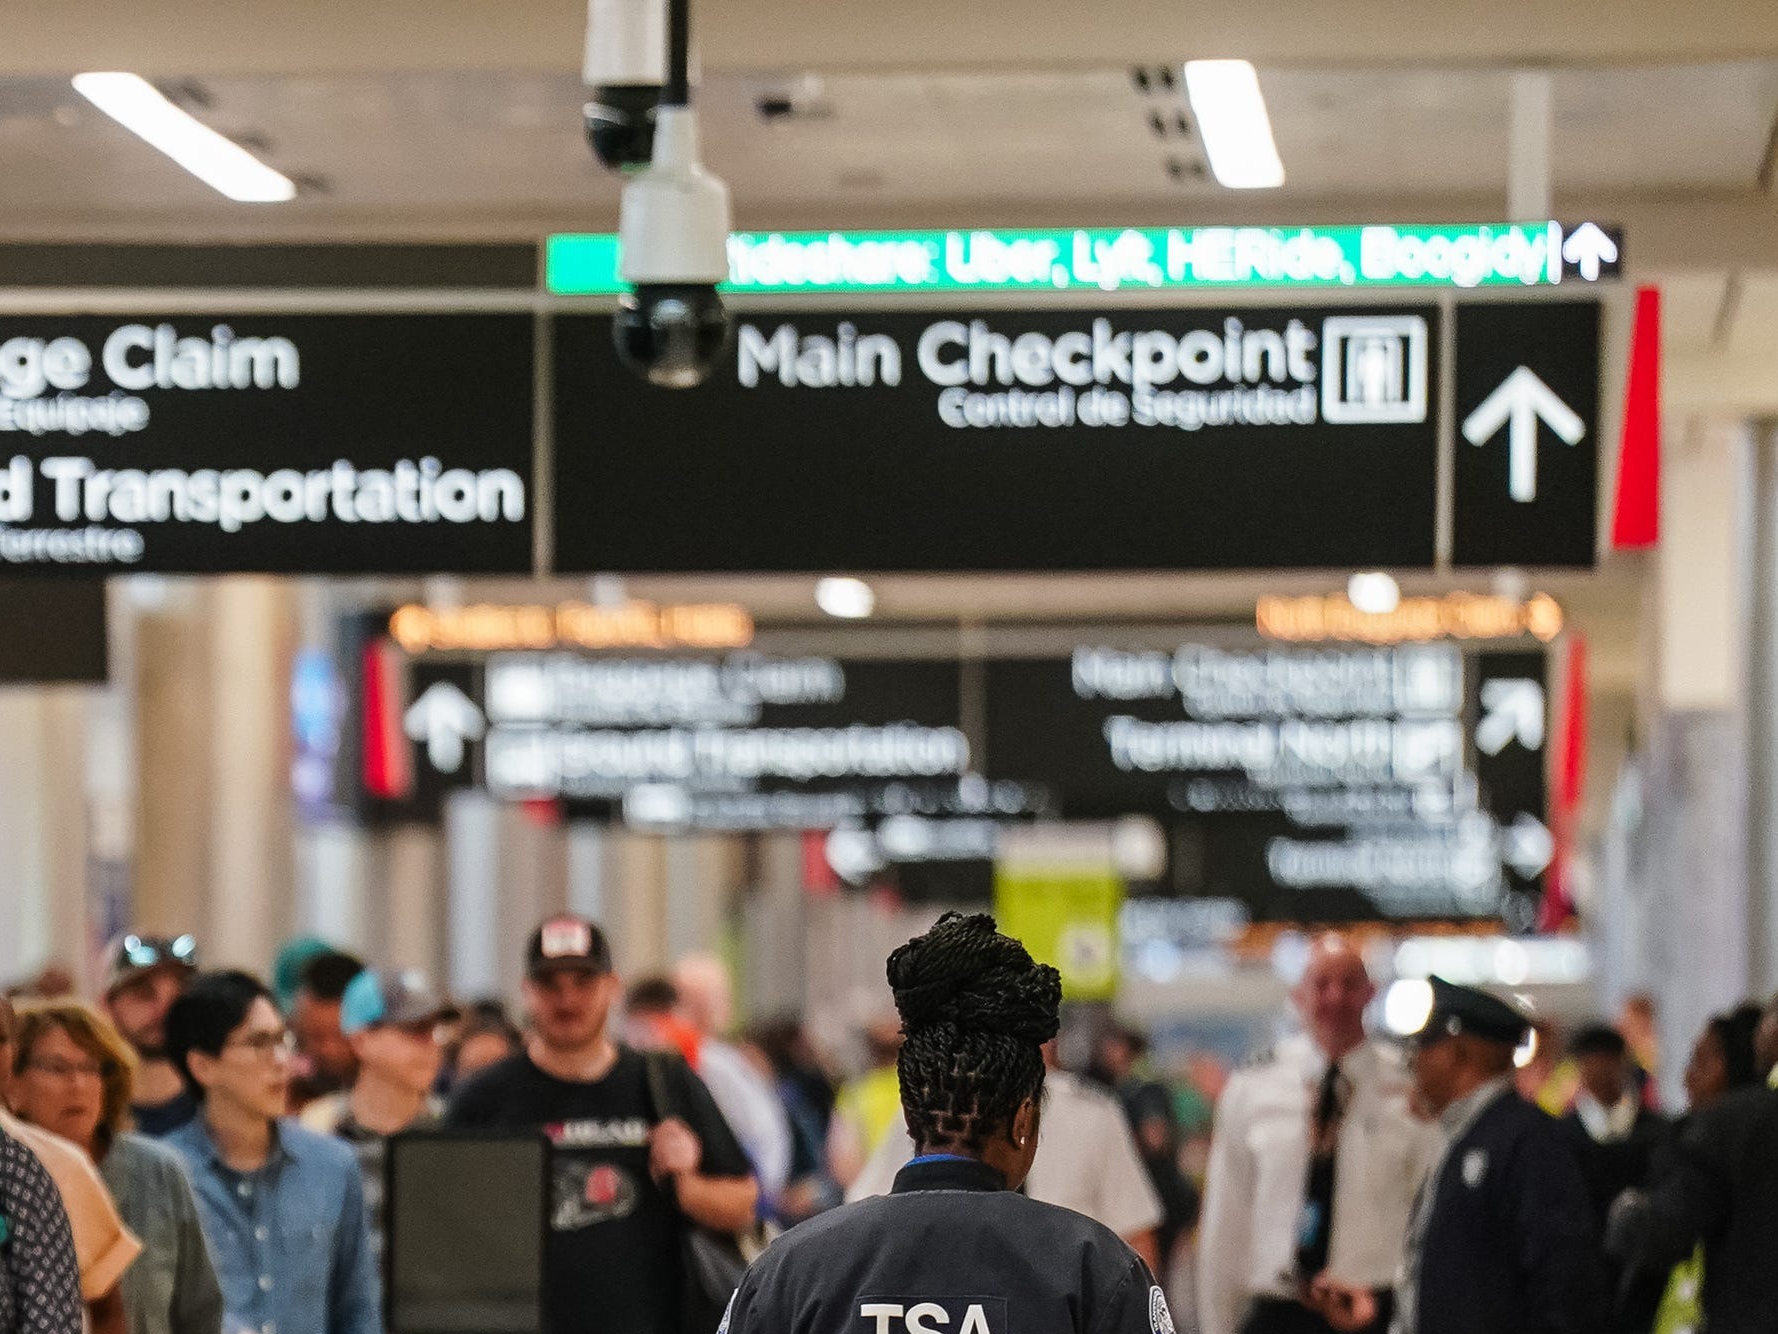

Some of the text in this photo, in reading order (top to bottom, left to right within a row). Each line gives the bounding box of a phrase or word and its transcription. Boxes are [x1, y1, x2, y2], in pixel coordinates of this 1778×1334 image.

[102, 323, 300, 389] Claim
[737, 316, 1318, 398] Main Checkpoint
[937, 383, 1318, 431] Control de Seguridad
[40, 455, 525, 533] Transportation
